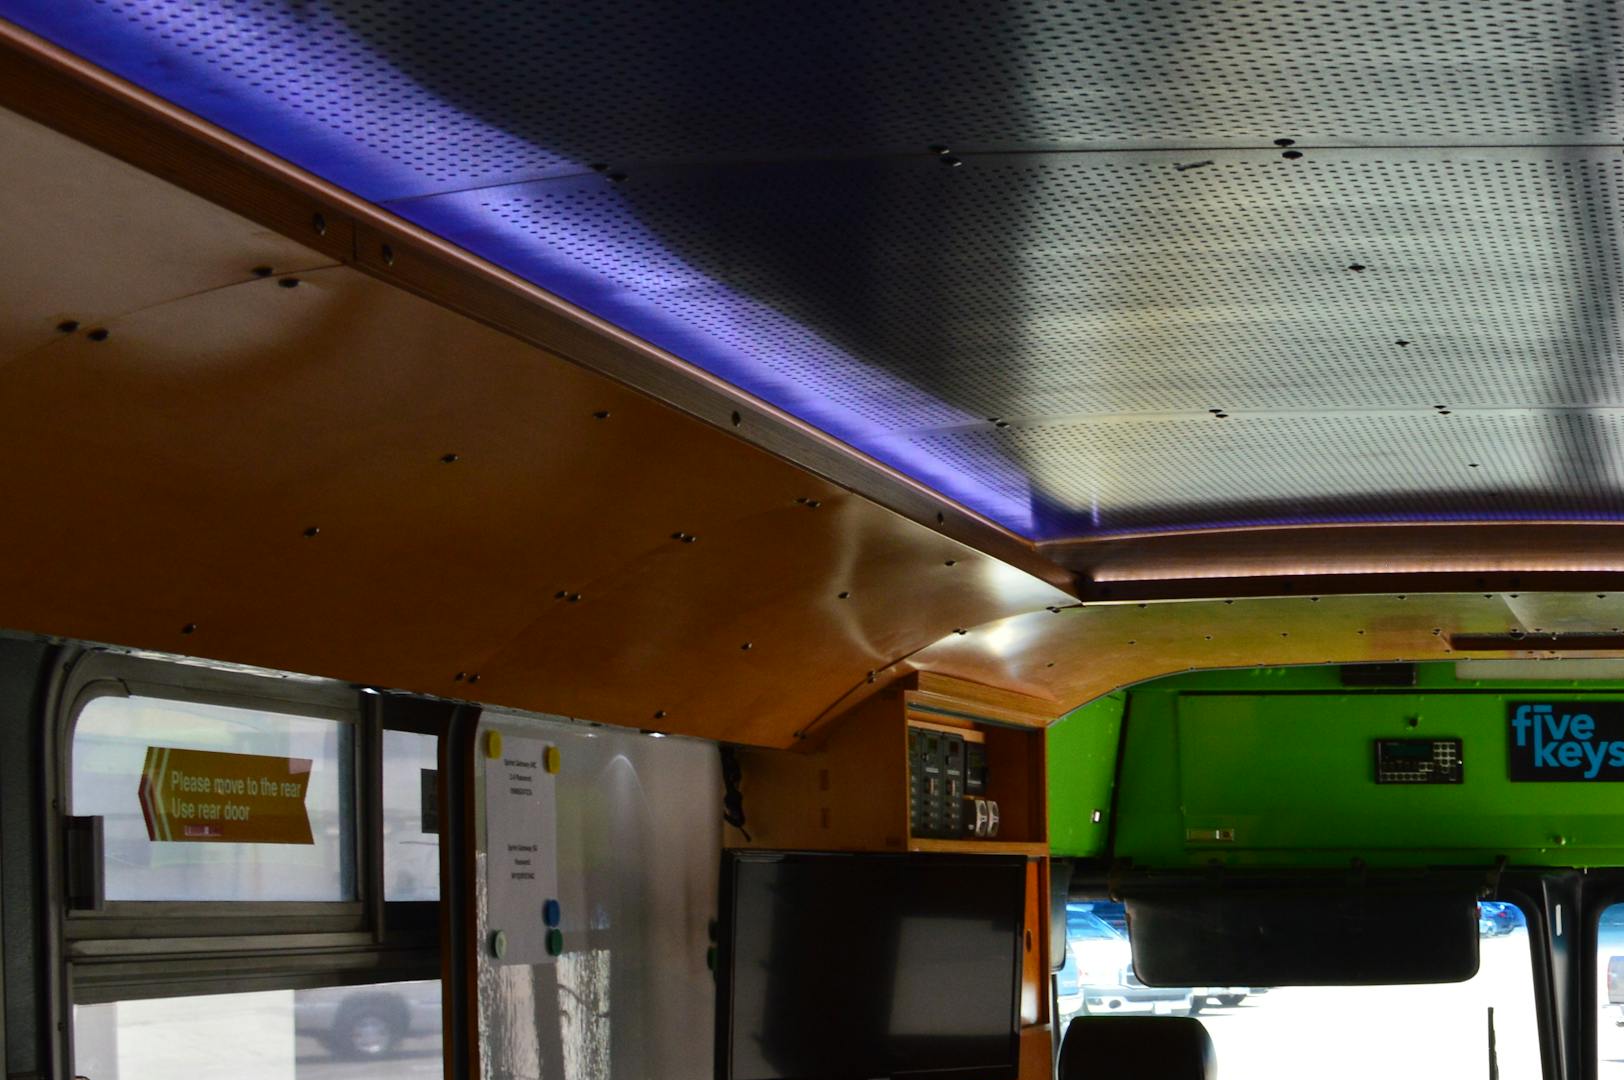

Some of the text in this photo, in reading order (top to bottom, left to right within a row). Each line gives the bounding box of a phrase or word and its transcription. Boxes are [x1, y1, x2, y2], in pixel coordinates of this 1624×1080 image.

[1511, 704, 1595, 747] five
[171, 770, 302, 798] Please move to the rear
[171, 797, 250, 821] Use rear door
